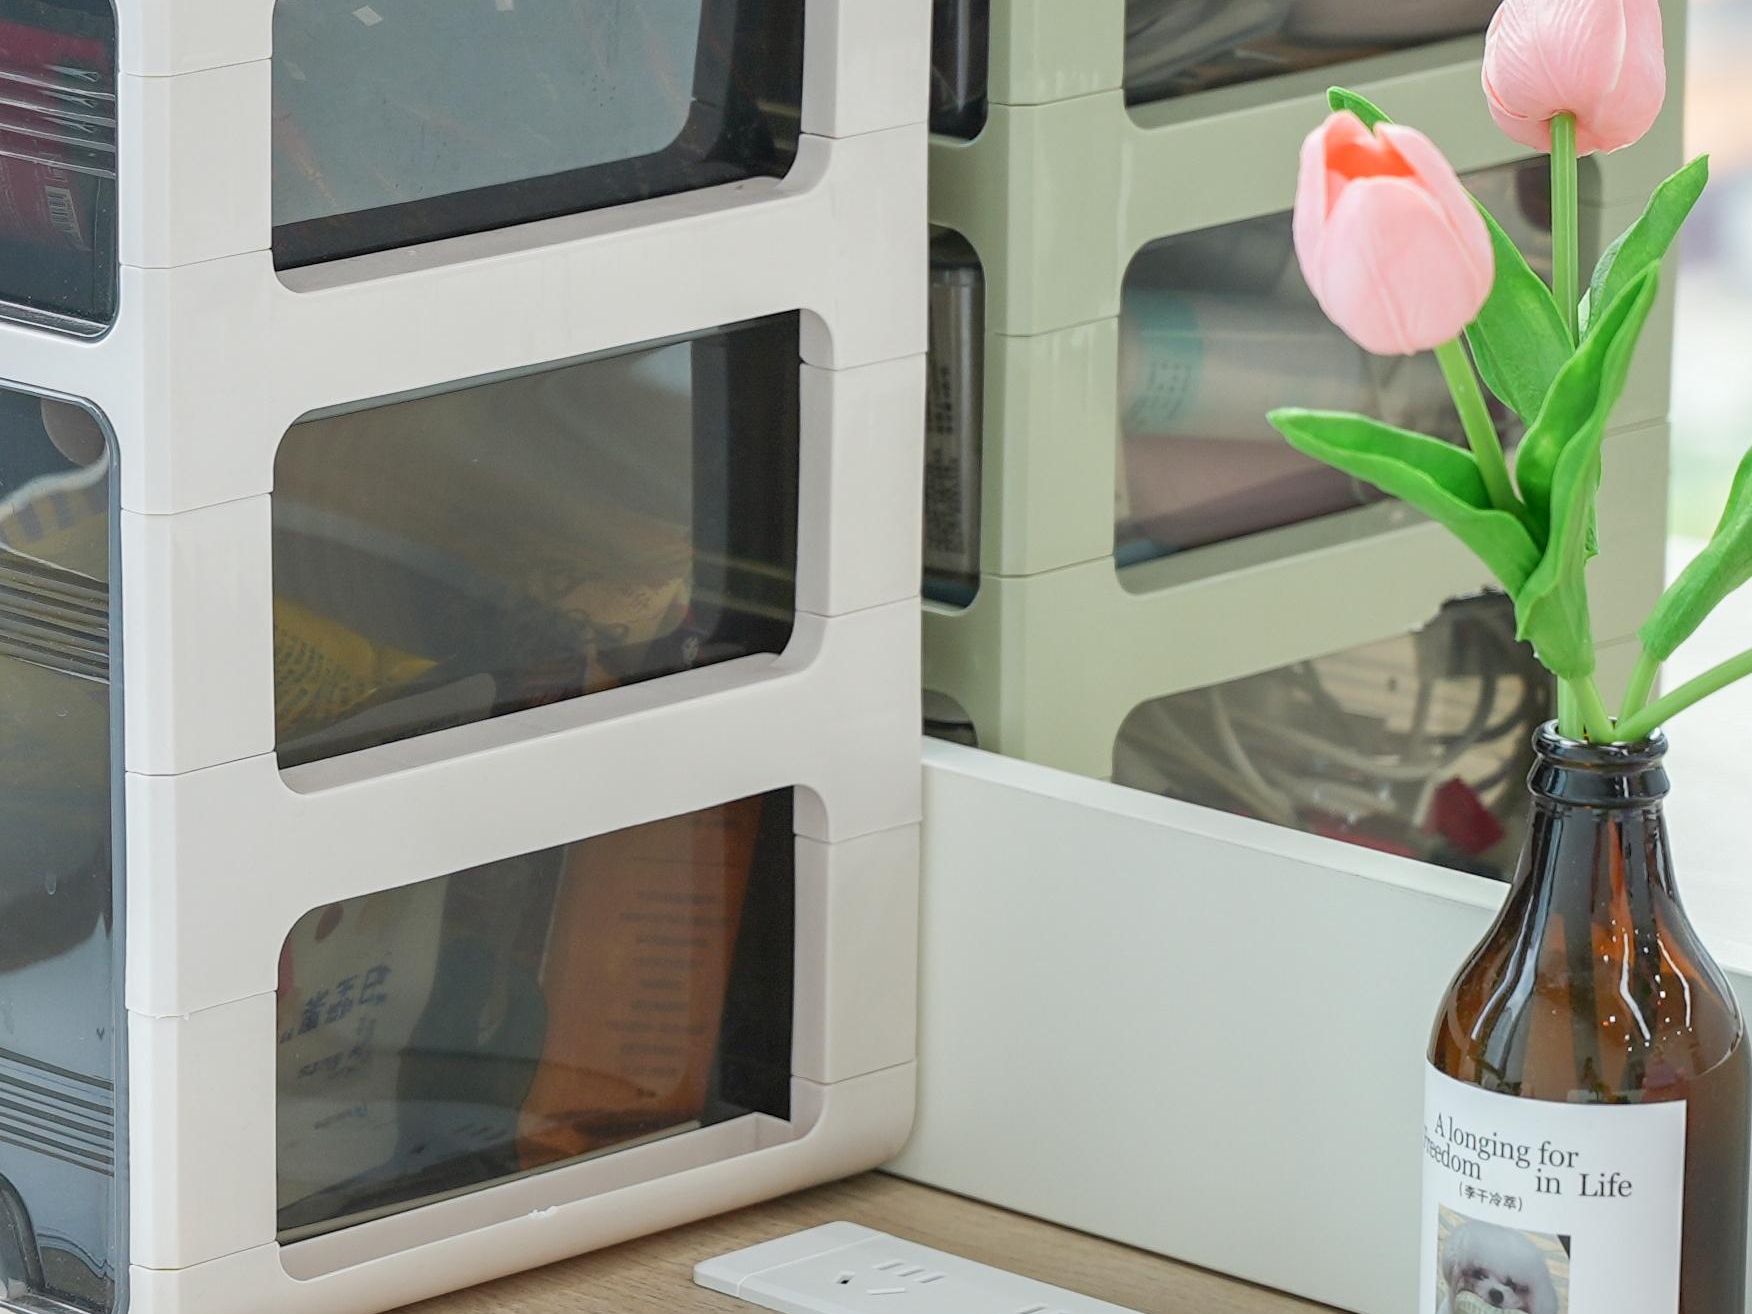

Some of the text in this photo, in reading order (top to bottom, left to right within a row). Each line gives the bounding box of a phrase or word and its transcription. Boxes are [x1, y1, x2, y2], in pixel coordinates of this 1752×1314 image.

[1434, 1112, 1579, 1170] A longing for
[1536, 1168, 1562, 1195] in
[1579, 1172, 1633, 1198] Life
